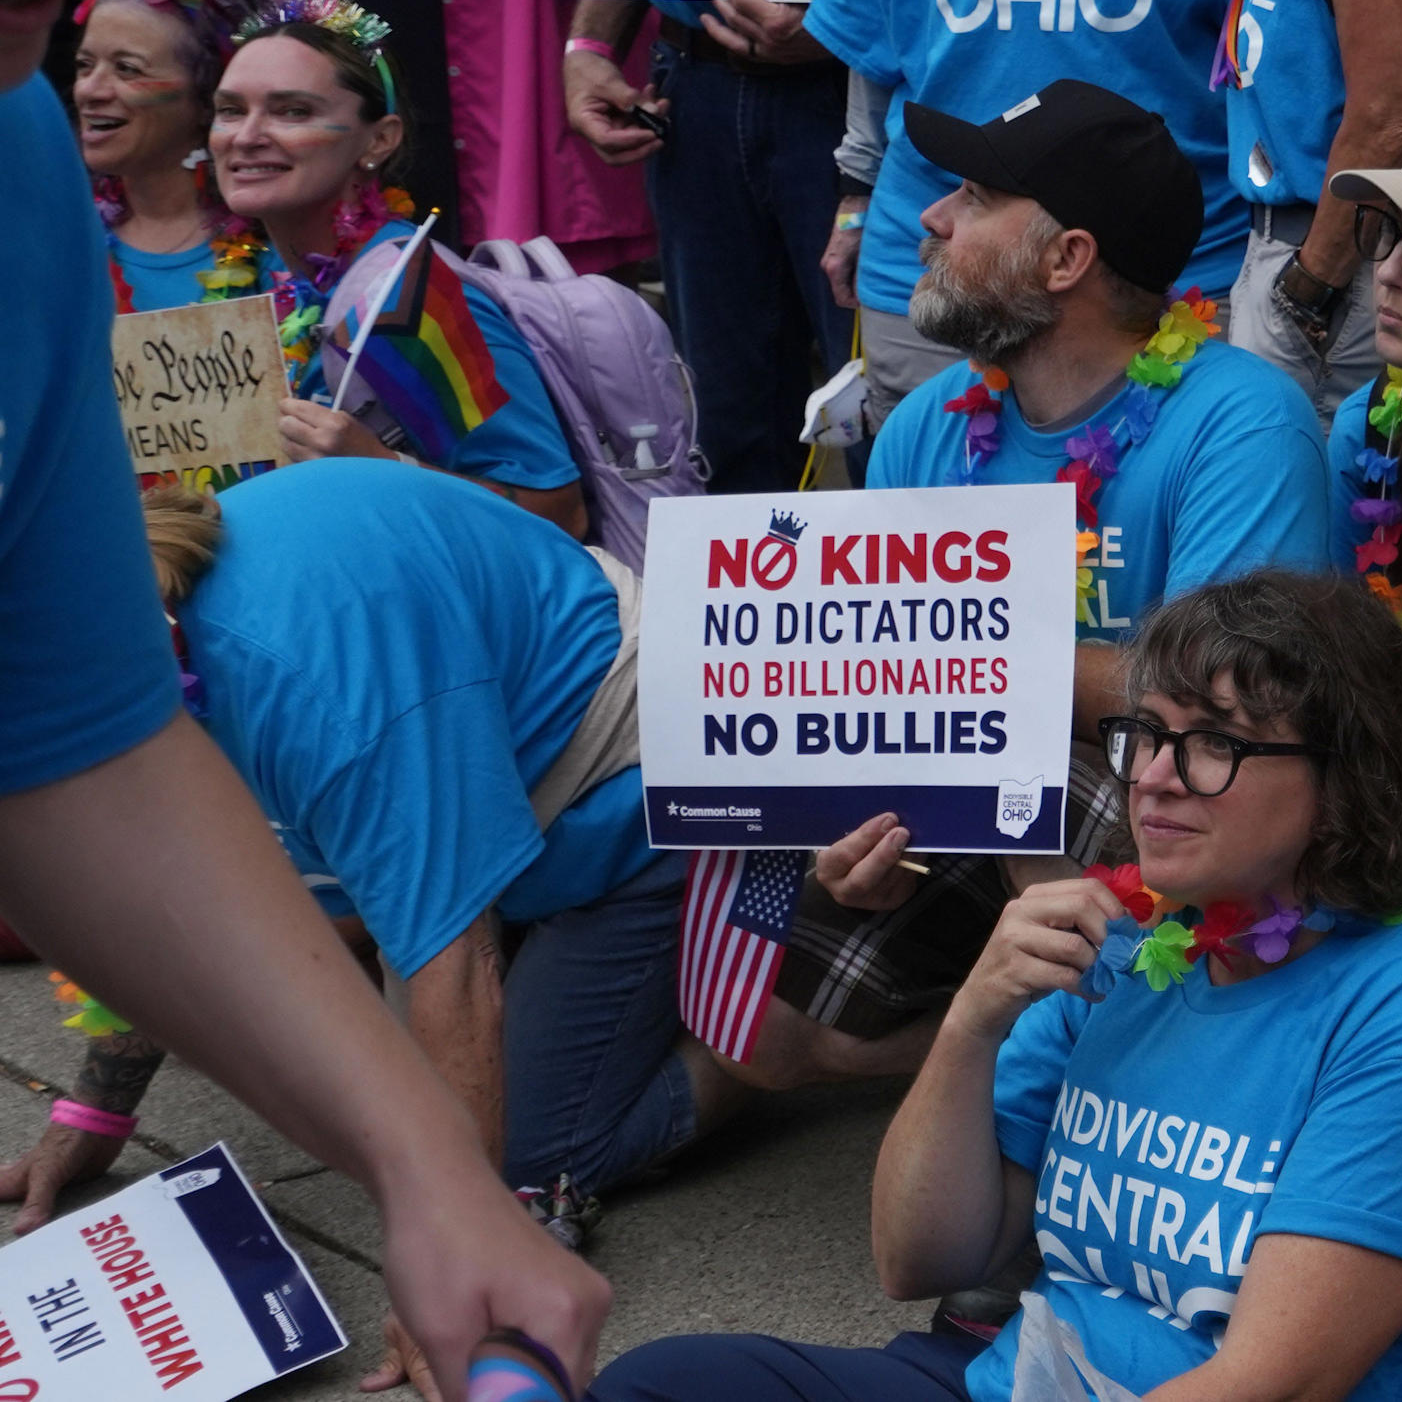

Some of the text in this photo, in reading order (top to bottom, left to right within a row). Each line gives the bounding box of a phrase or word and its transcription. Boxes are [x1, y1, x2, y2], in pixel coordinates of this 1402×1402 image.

[143, 330, 266, 413] People
[707, 530, 1011, 591] NO KINGS
[704, 597, 1010, 646] NO DICTATORS
[704, 657, 1008, 698] NO BILLIONAIRES
[704, 710, 1008, 757] NO BULLIES
[680, 805, 762, 817] Common Cause
[1002, 808, 1033, 822] OHIO
[1003, 800, 1033, 809] CENTRAL
[1051, 1080, 1282, 1195] NDIVISIBLE
[26, 1277, 106, 1363] IN THE
[79, 1213, 204, 1391] WHITE HOUSE
